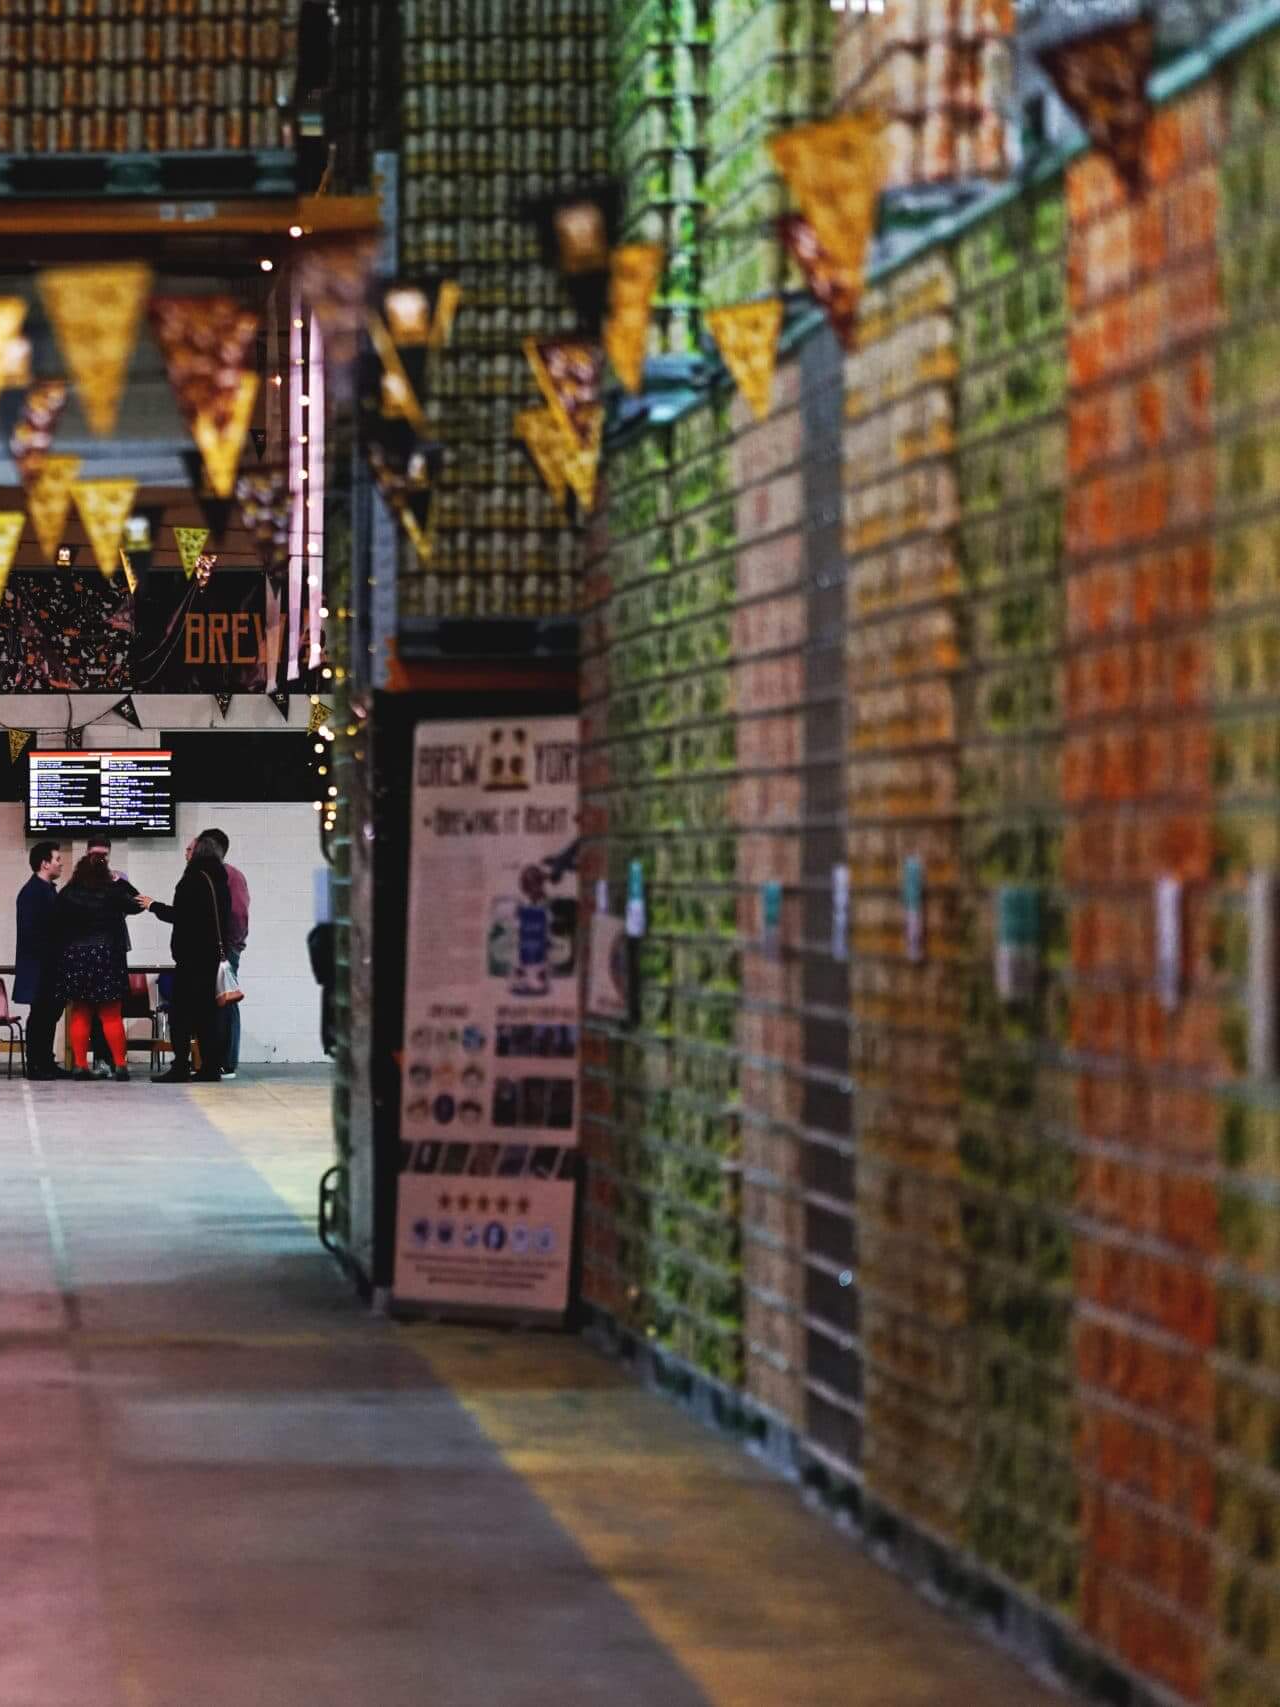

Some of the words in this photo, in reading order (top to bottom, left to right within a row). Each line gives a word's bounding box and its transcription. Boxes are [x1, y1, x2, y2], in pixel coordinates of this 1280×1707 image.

[184, 613, 287, 665] BREW
[417, 745, 481, 787] BREW
[534, 741, 577, 785] YOR
